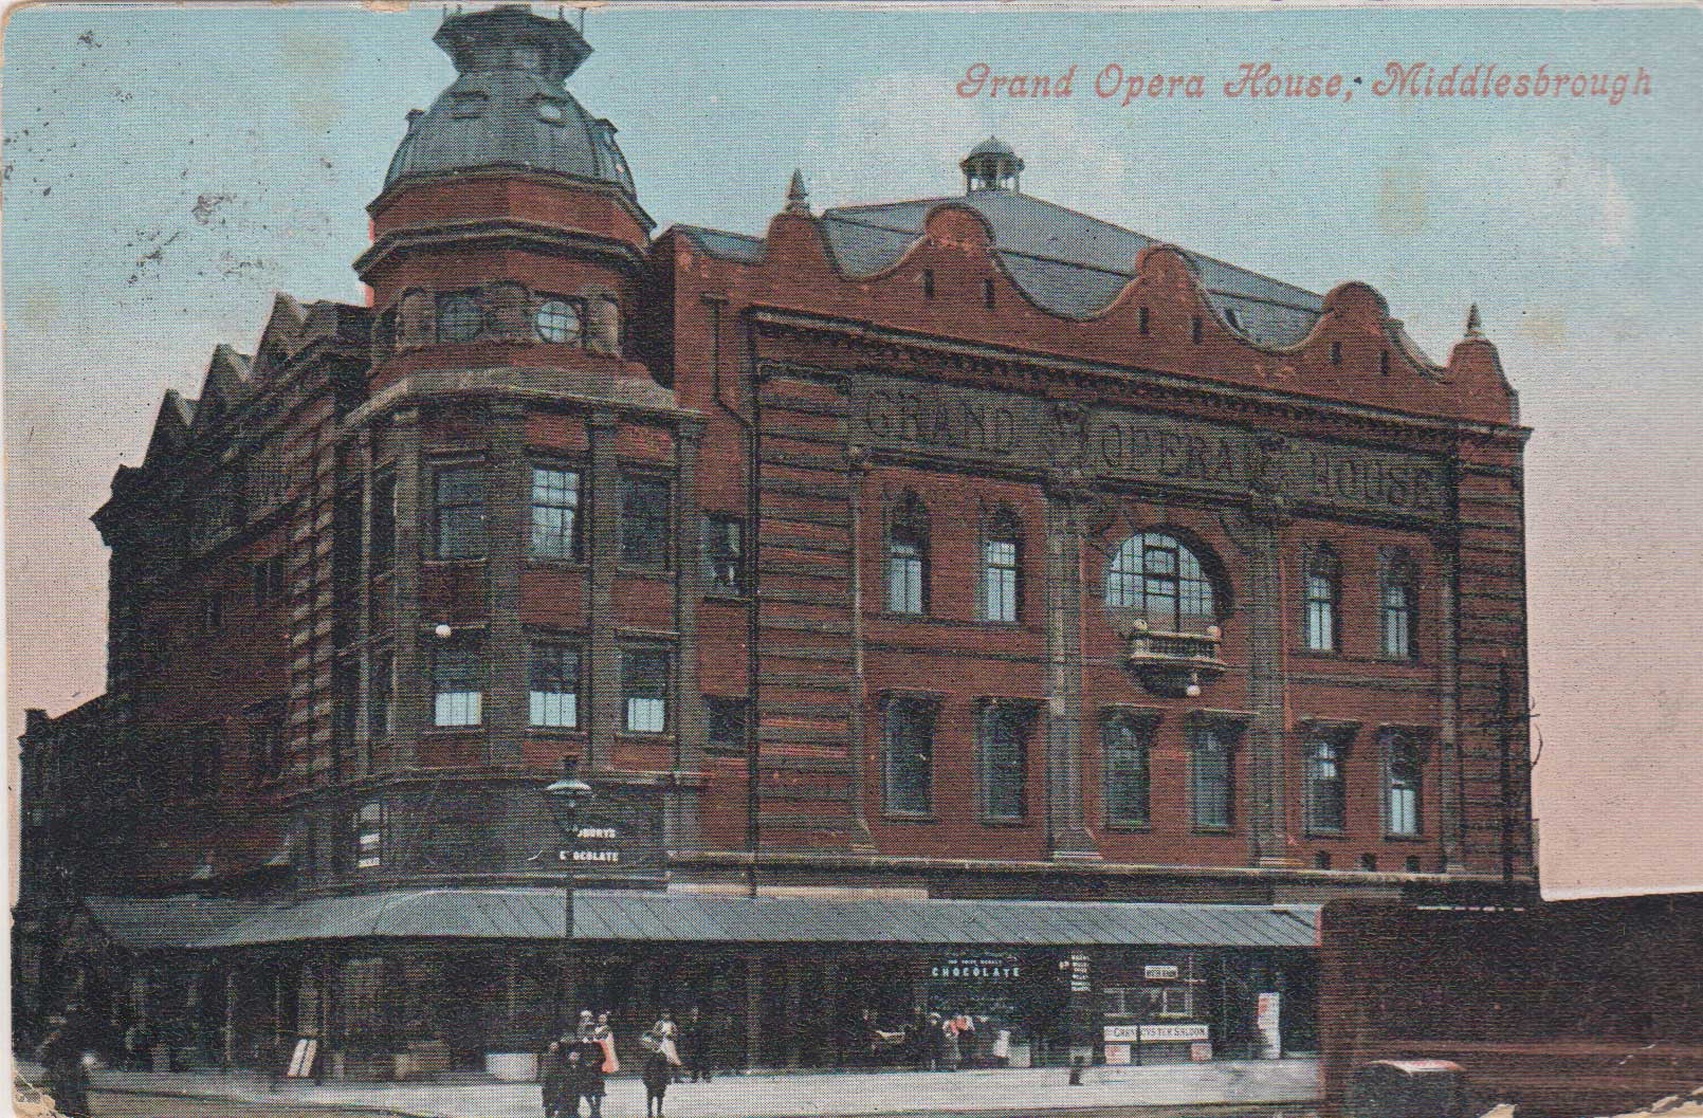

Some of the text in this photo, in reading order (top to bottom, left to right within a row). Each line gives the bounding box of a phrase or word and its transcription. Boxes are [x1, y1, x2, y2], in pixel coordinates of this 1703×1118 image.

[863, 389, 1436, 511] GRAND OPERA HOUSE
[559, 850, 619, 862] COCOLATE
[932, 966, 1020, 977] CHOCOLATE
